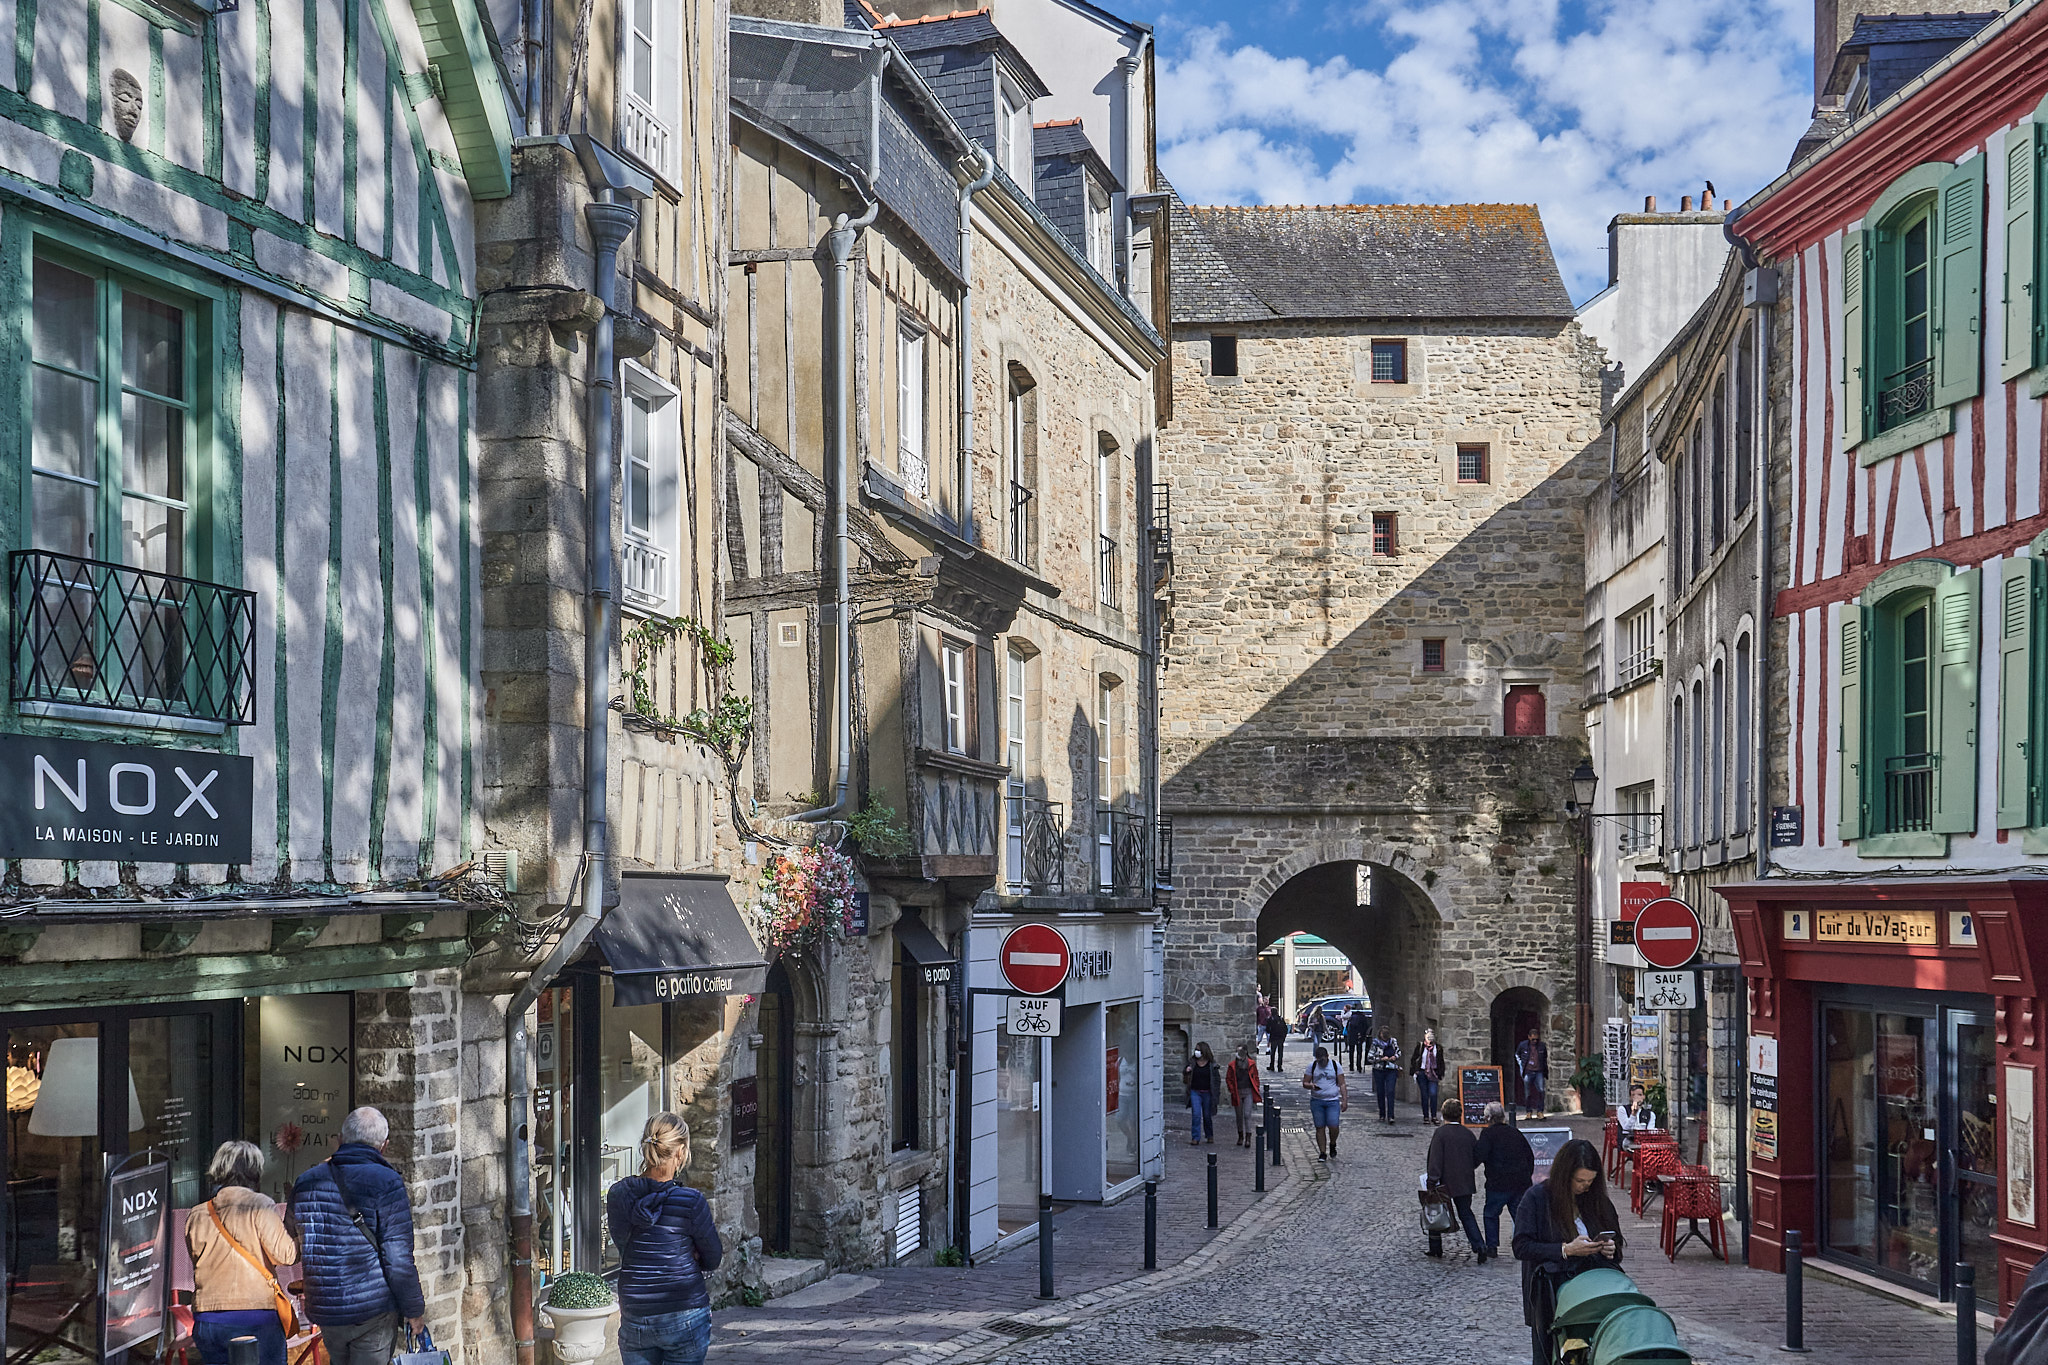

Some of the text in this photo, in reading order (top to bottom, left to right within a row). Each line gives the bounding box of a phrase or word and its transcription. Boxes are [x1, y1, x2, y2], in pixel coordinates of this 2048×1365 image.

[34, 754, 219, 820] NOX
[35, 826, 55, 841] LA
[63, 827, 122, 843] MAISON
[141, 831, 158, 845] LE
[166, 832, 219, 847] JARDIN
[1623, 897, 1652, 905] ETIEN
[1792, 914, 1801, 931] 2
[1819, 915, 1843, 935] Cuir
[1848, 916, 1861, 936] du
[1961, 915, 1972, 936] 2
[1299, 957, 1337, 965] MEPHISTO
[924, 965, 951, 985] le patio
[1655, 974, 1683, 984] SAUF
[655, 973, 733, 1000] le patio Coiffeur
[1019, 1000, 1049, 1011] SAUF
[284, 1045, 348, 1064] NOX
[1753, 1074, 1775, 1087] Fabricant
[293, 1088, 319, 1101] 300
[1750, 1086, 1778, 1100] de ceintures
[1755, 1099, 1773, 1110] en Cuir
[302, 1114, 330, 1125] pour
[122, 1188, 158, 1216] NOX
